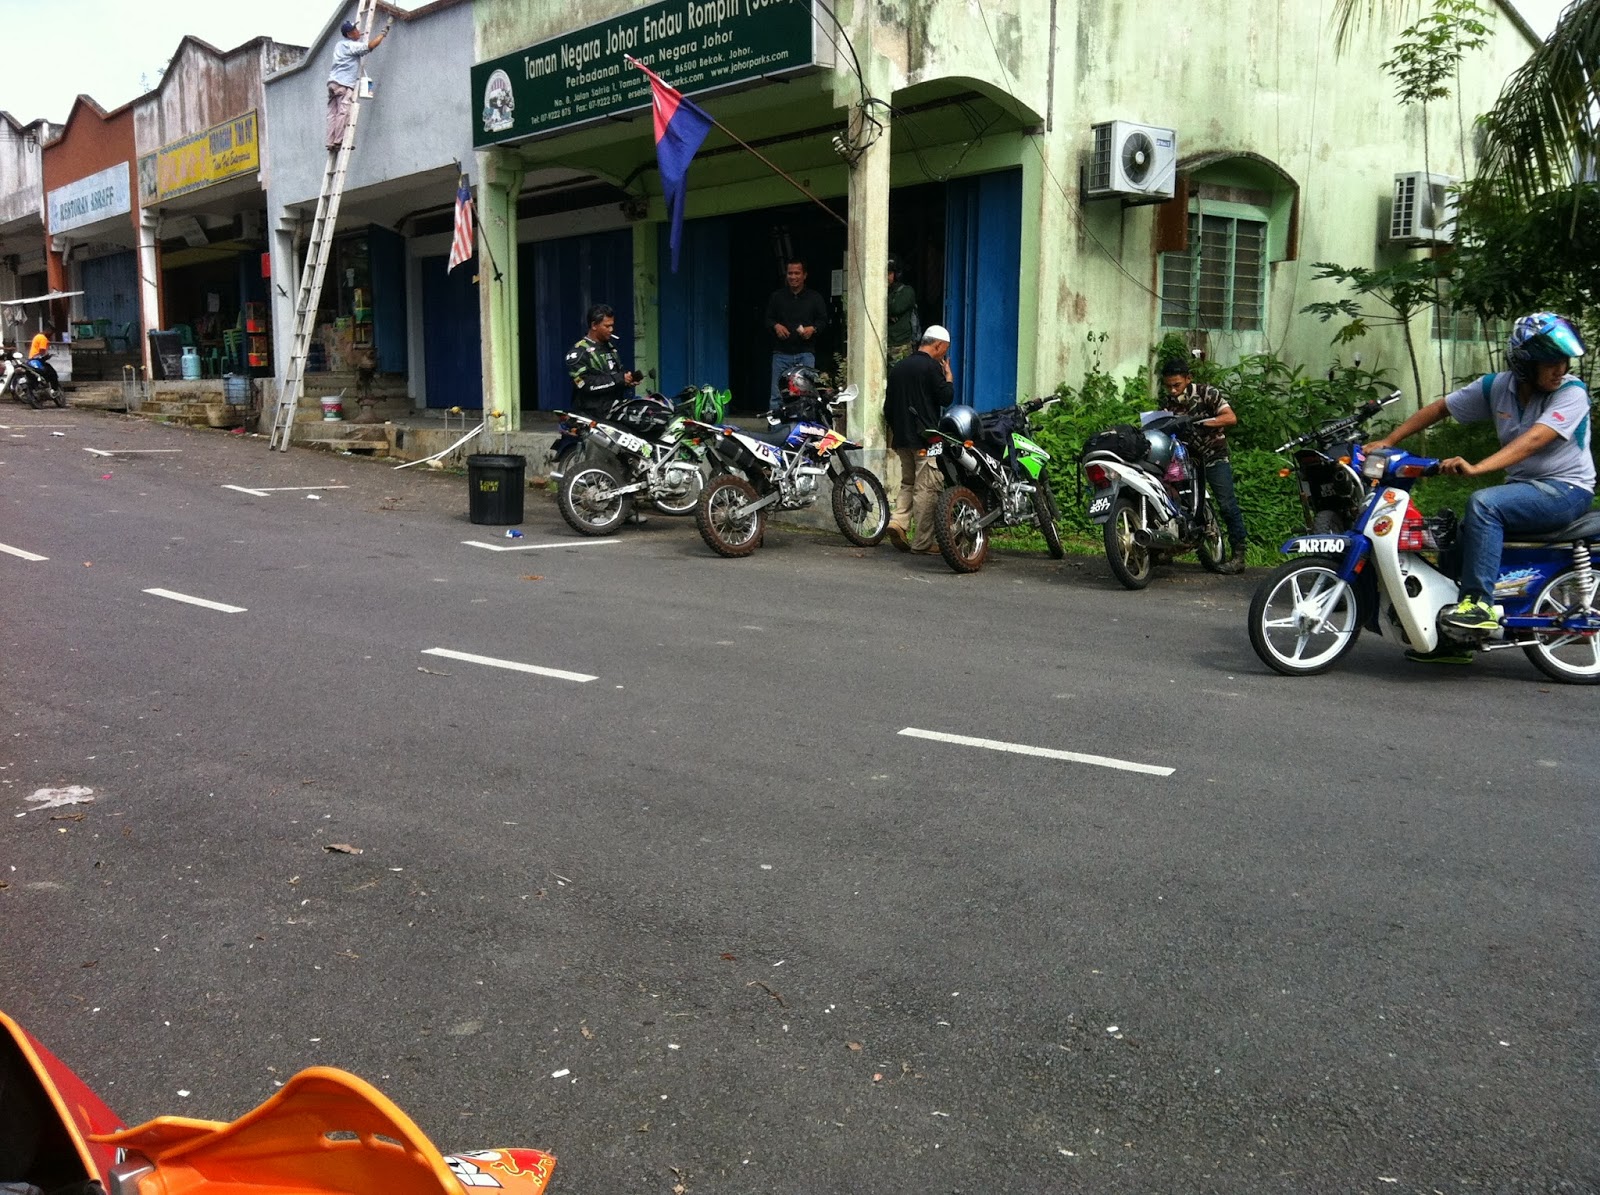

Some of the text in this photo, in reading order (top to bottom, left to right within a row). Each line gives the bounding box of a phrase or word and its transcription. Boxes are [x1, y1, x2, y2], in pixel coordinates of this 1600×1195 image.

[524, 53, 557, 80] Taman
[561, 39, 600, 71] Negara
[605, 25, 638, 55] Johor
[644, 10, 682, 43] Endau
[688, 0, 739, 28] Rompin
[566, 64, 619, 89] Perbadanan
[659, 41, 697, 61] Negara
[702, 30, 733, 49] Johor
[619, 78, 641, 89] Taman
[674, 60, 697, 74] 86500
[728, 46, 754, 60] Johor.
[710, 50, 789, 77] www.johorparks.com
[1089, 503, 1111, 513] 2077
[1093, 497, 1108, 506] JKA
[1298, 539, 1345, 553] JKR1760
